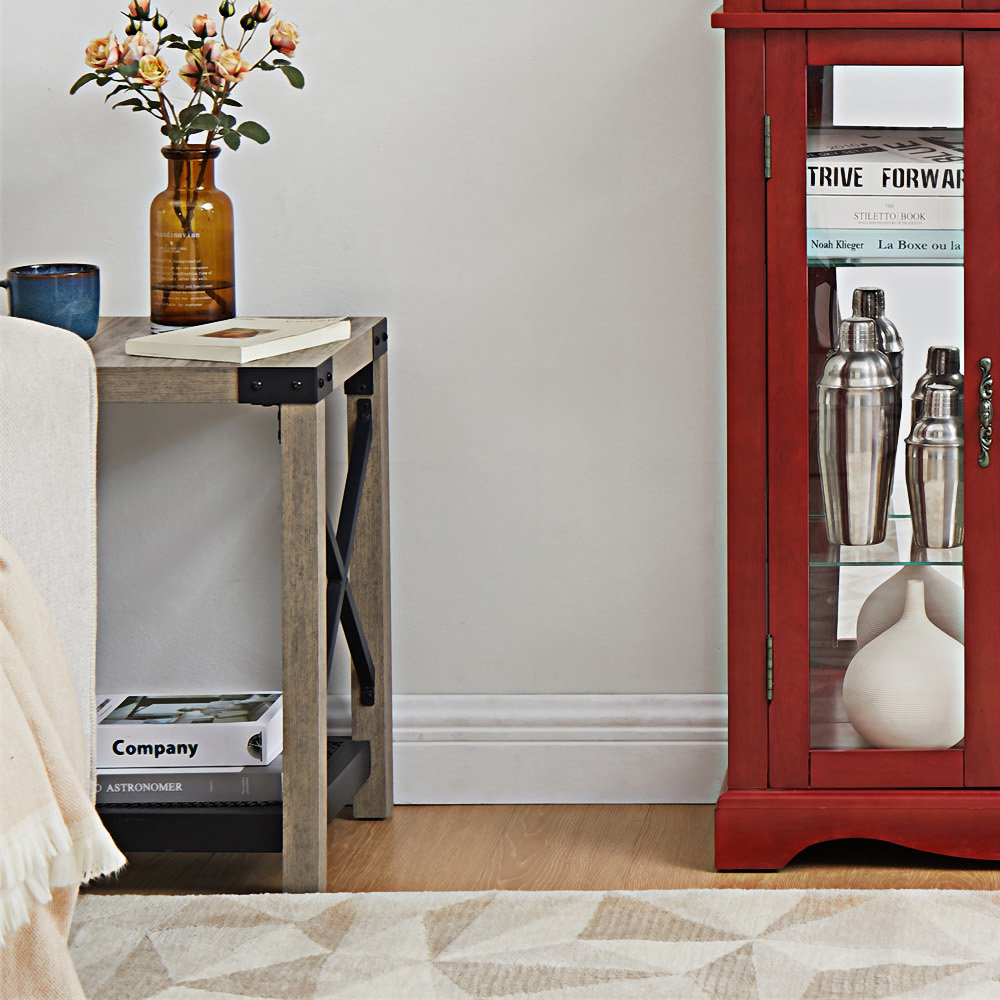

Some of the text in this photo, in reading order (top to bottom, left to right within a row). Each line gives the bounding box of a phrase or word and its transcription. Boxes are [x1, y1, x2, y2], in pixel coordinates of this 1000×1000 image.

[807, 166, 863, 187] TRIVE
[853, 212, 926, 221] STILETTO BOOK
[811, 240, 833, 249] Noah
[836, 240, 864, 251] Klieger
[878, 239, 893, 250] La
[898, 240, 928, 250] Boxe
[951, 240, 961, 250] la
[112, 739, 199, 758] Company
[106, 782, 183, 792] ASTRONOMER
